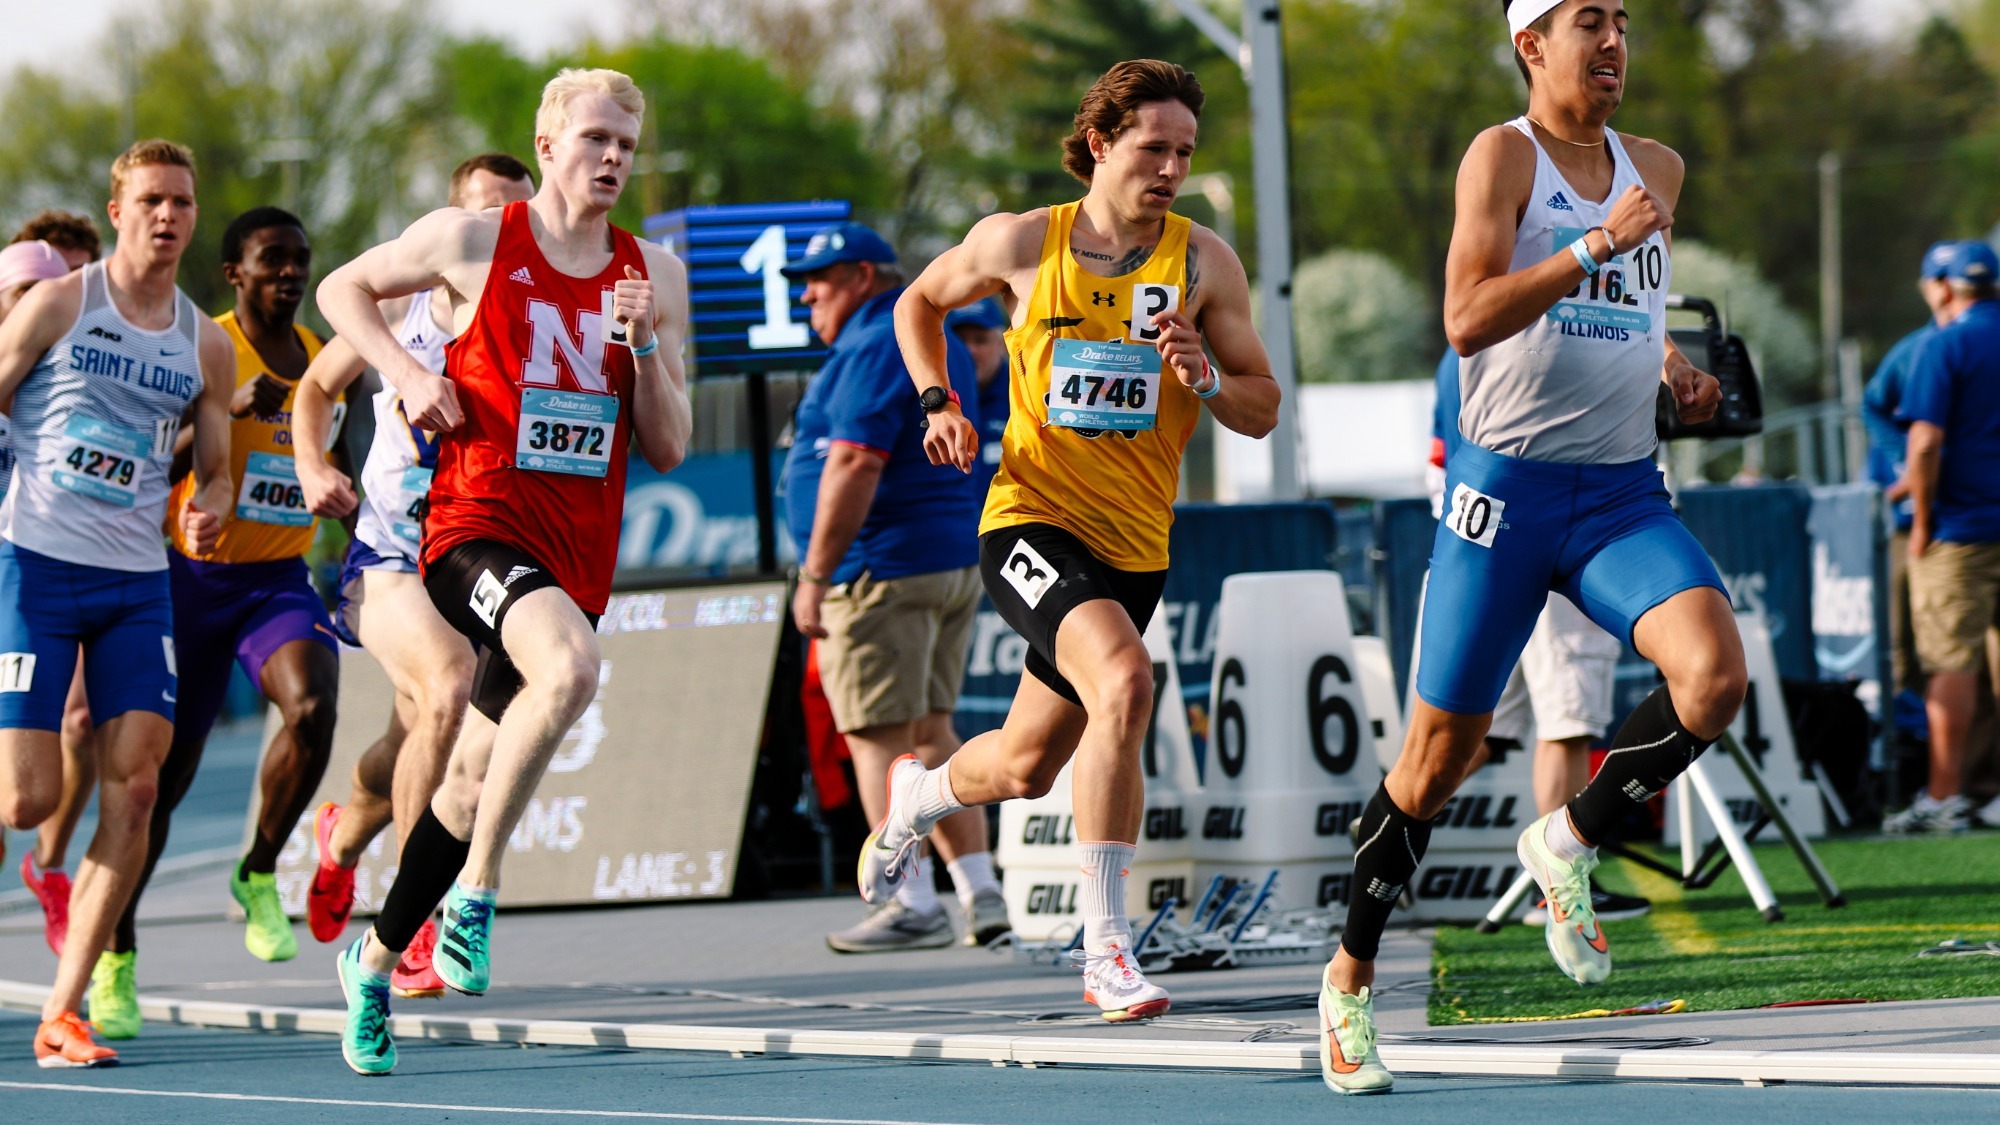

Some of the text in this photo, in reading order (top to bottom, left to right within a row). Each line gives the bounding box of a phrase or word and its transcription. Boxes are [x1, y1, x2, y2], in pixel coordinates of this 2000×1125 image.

[1547, 200, 1573, 212] adidas
[1081, 250, 1115, 262] MMXIV
[1633, 245, 1662, 291] 10
[509, 274, 535, 286] adidas
[740, 225, 810, 349] 1
[1139, 287, 1169, 340] 3
[1560, 321, 1630, 342] ILLINOIS
[520, 297, 611, 395] N
[1080, 347, 1142, 363] Drake RELAYS
[70, 344, 194, 401] SAINT LOUIS
[548, 396, 579, 410] Drake
[579, 403, 604, 413] RELAYS
[1061, 374, 1148, 409] 4746
[529, 420, 605, 457] 3872
[67, 446, 135, 486] 4279
[1457, 490, 1492, 540] 10
[503, 567, 539, 588] adidas
[1009, 552, 1049, 600] 3
[474, 578, 498, 618] 5
[1216, 657, 1246, 779] 6
[1306, 655, 1360, 776] 6
[1022, 814, 1073, 845] GILL
[1145, 806, 1187, 840] GILL
[1202, 806, 1246, 840] GILL
[1027, 884, 1078, 915] GILL
